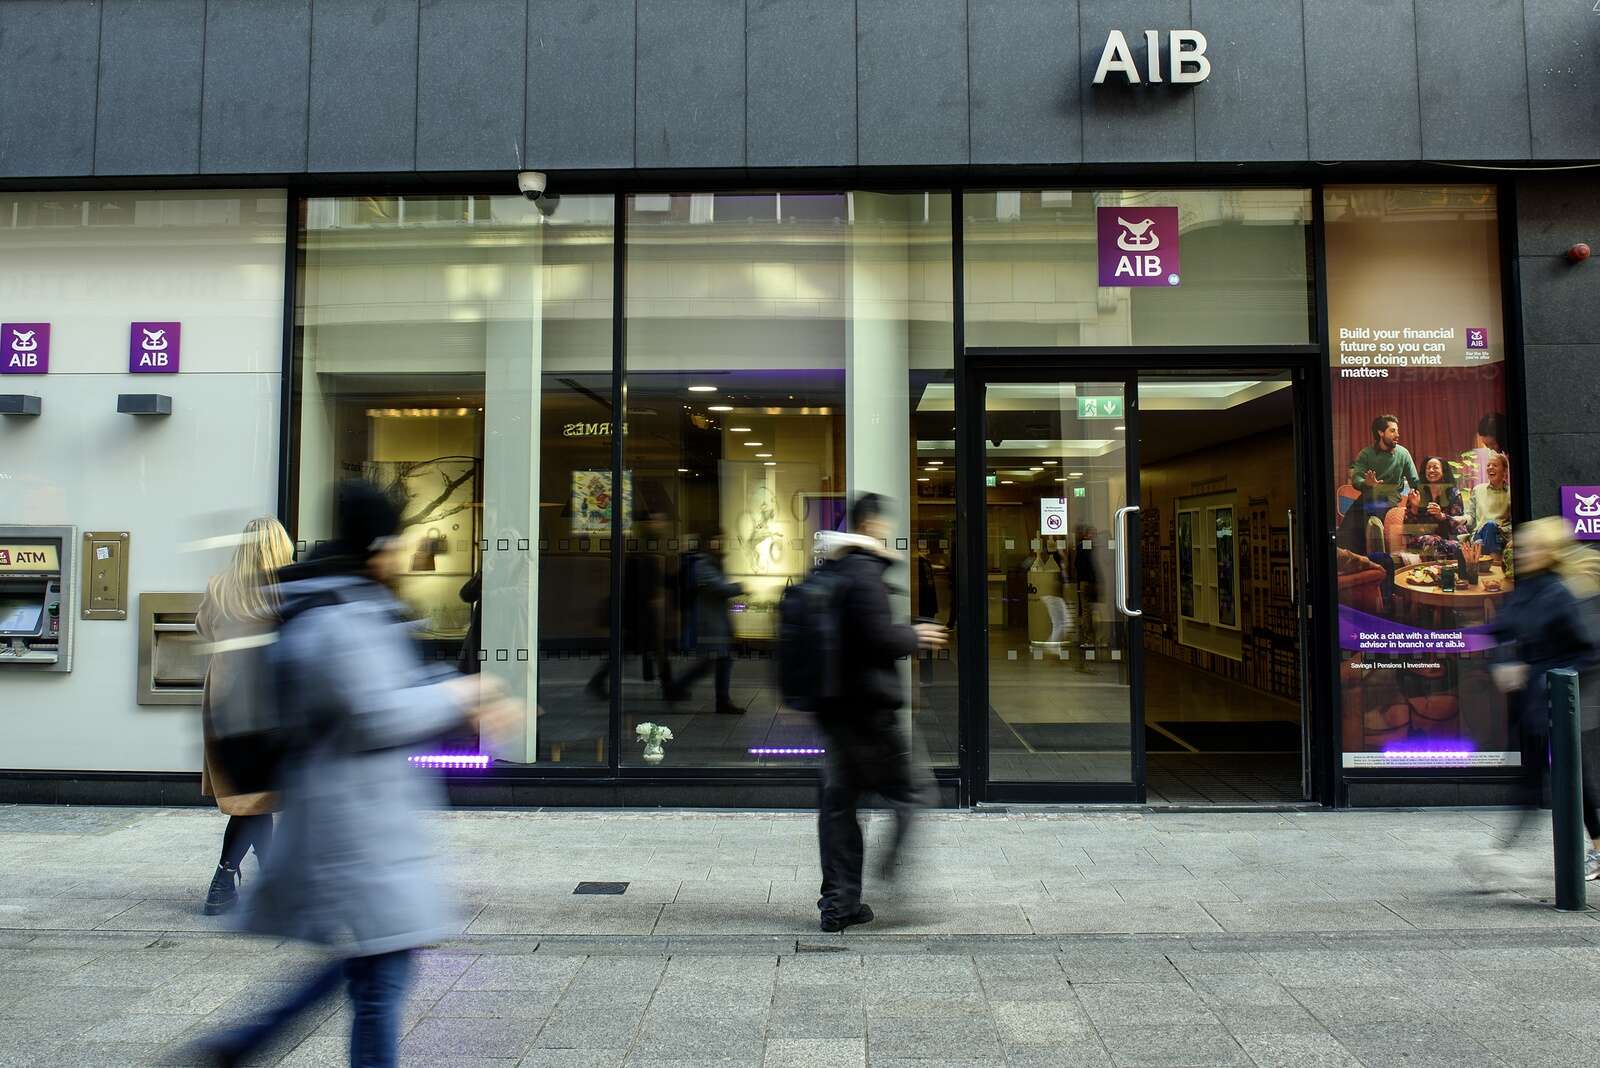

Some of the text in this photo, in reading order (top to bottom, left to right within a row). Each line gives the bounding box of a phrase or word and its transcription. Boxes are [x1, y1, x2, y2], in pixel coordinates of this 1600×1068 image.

[1092, 29, 1211, 84] AIB
[1114, 255, 1162, 277] AIB
[1340, 328, 1455, 340] Build your financial
[1340, 341, 1446, 354] future so you can
[9, 353, 38, 367] AIB
[139, 352, 169, 366] AIB
[1340, 354, 1442, 367] keep doing what
[1341, 367, 1389, 378] matters
[16, 552, 46, 563] ATM
[1360, 632, 1379, 640] Book
[1387, 632, 1405, 640] chat
[1405, 632, 1422, 640] with
[1430, 632, 1462, 640] financial
